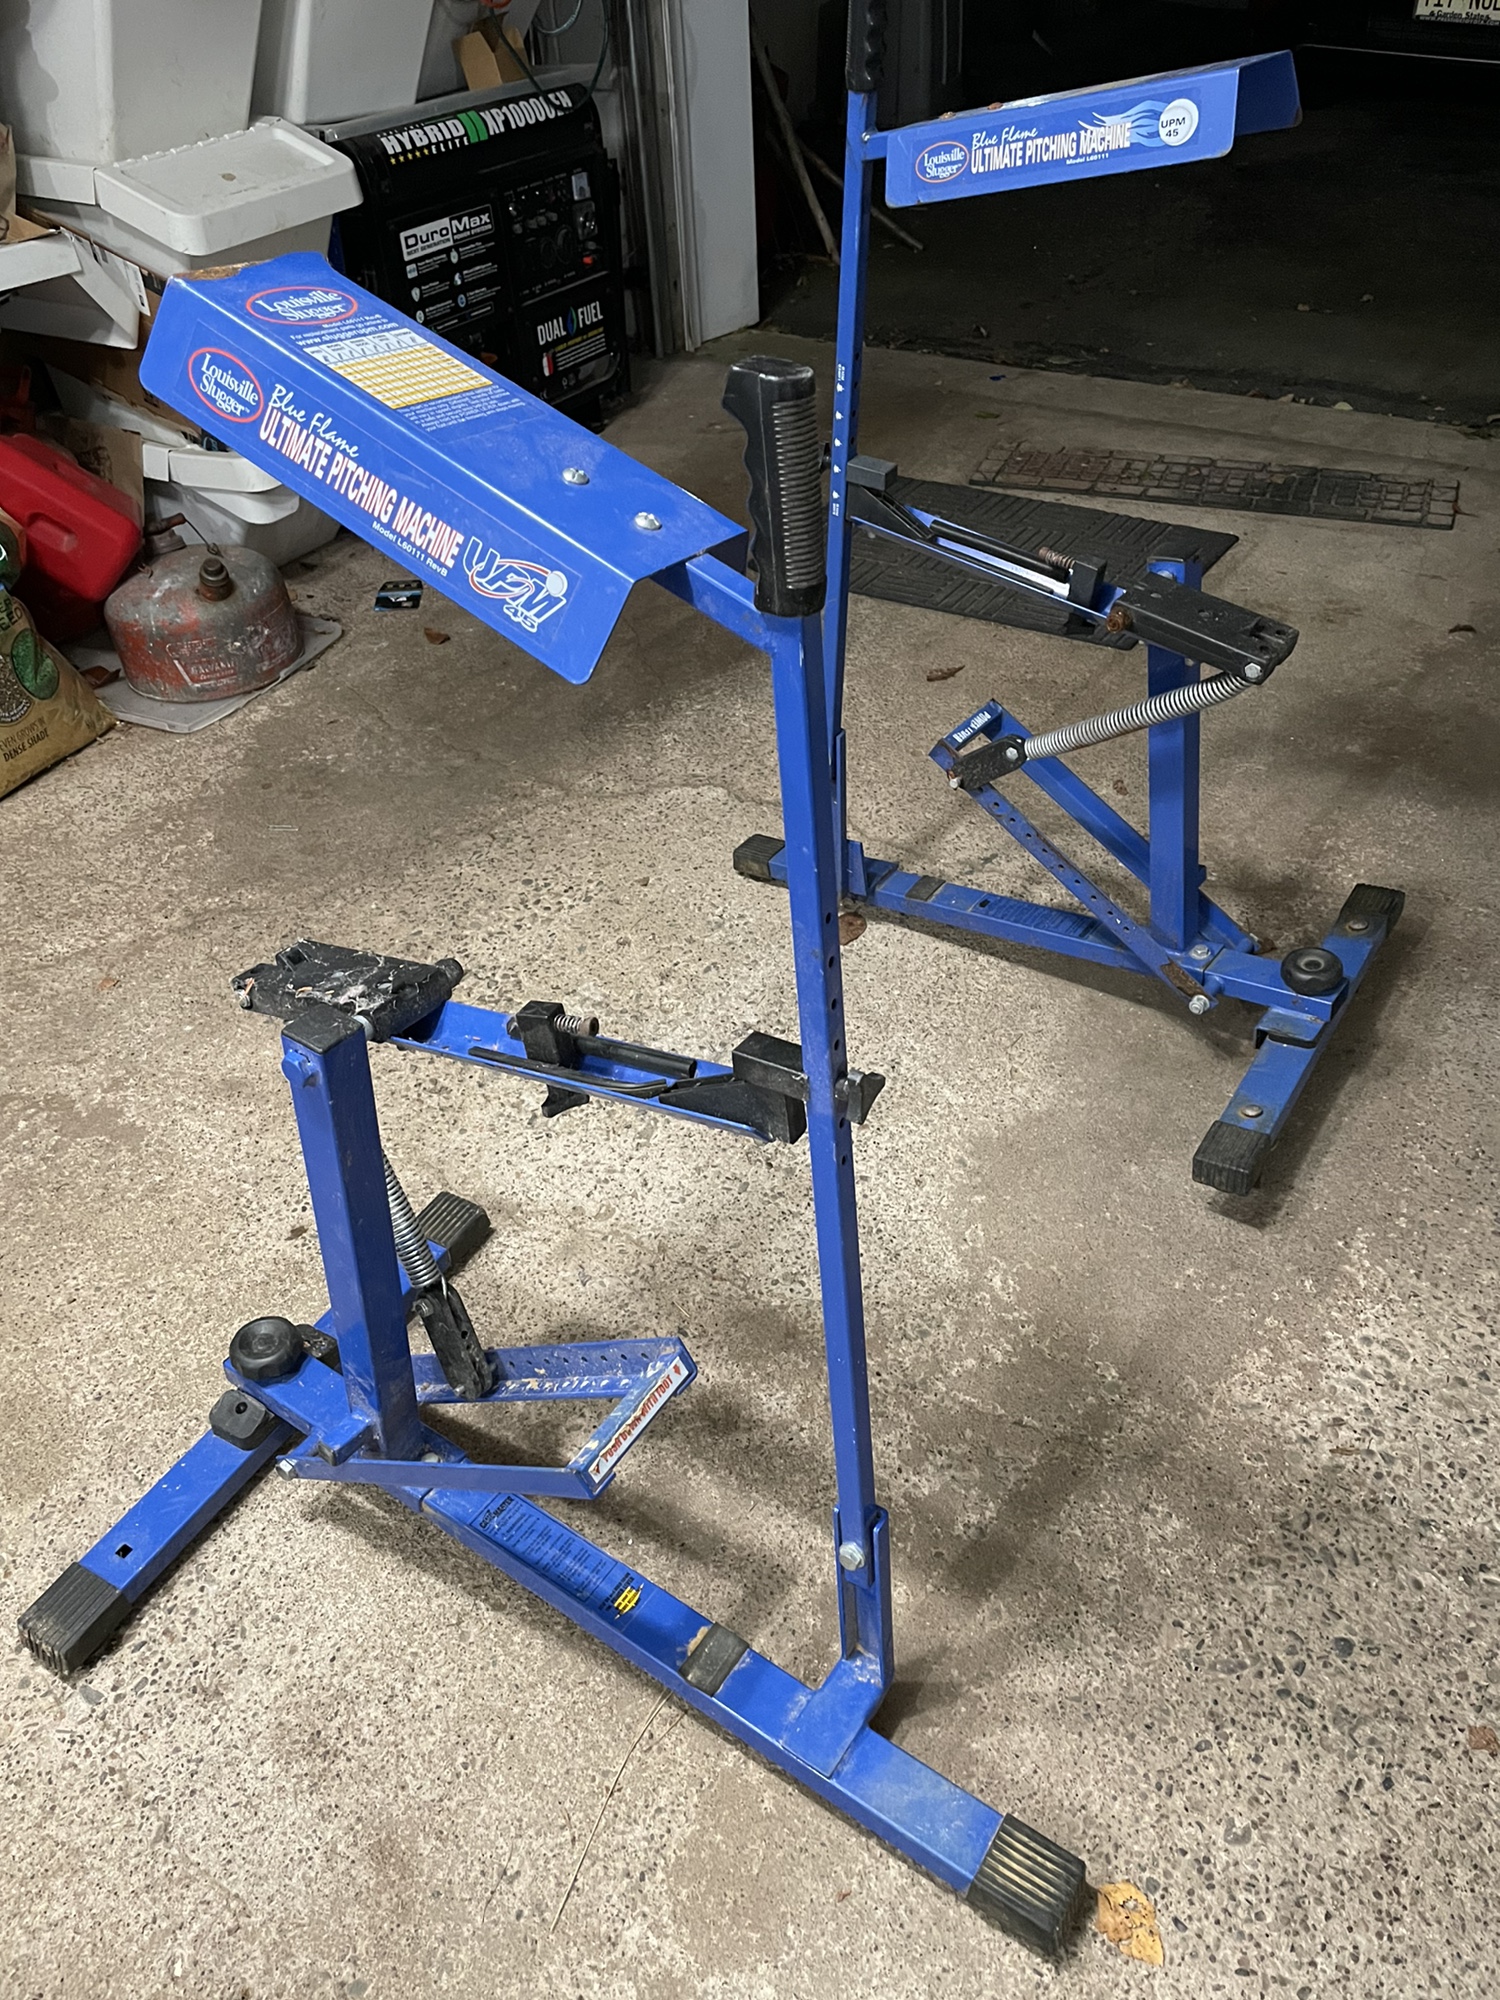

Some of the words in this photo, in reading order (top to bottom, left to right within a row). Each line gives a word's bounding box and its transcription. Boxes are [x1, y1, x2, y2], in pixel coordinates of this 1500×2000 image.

[380, 118, 465, 155] HYBRID
[971, 132, 998, 150] Blue
[1001, 126, 1039, 148] Flame
[1160, 117, 1186, 128] UPM
[1165, 129, 1179, 138] 45
[432, 136, 469, 154] ELITE
[923, 148, 965, 167] Louisville
[971, 141, 1023, 174] ULTIMATE
[1025, 133, 1077, 165] PITCHING
[1079, 122, 1131, 156] MACHINE
[404, 213, 490, 250] DuroMax
[255, 290, 342, 312] Louisville
[537, 316, 566, 345] DUAL
[578, 301, 604, 328] FUEL
[201, 353, 258, 405] Louisville
[269, 384, 307, 422] Blue
[308, 412, 360, 458] Flame
[259, 404, 333, 479] ULTIMATE
[326, 451, 398, 524] PITCHING
[392, 496, 465, 568] MACHINE
[372, 520, 396, 542] Model
[397, 537, 425, 562] L60111
[426, 556, 448, 577] RevB
[463, 536, 567, 623] UPM
[503, 604, 539, 633] 45
[3, 742, 27, 762] DENSE
[27, 727, 49, 748] SHADE
[656, 1374, 673, 1398] FOOT
